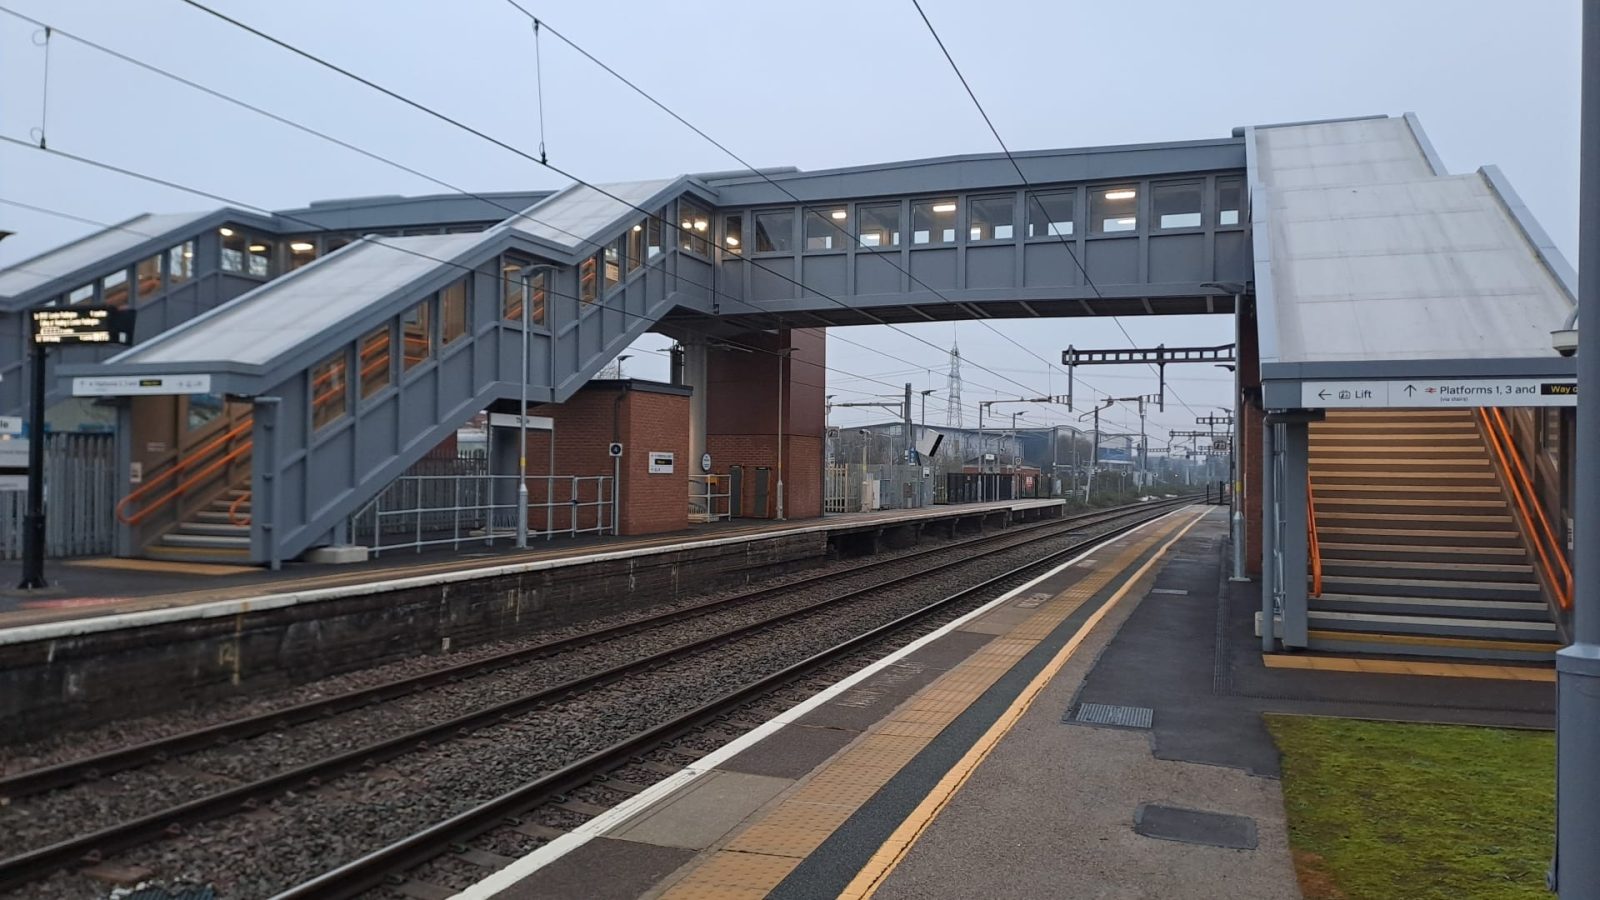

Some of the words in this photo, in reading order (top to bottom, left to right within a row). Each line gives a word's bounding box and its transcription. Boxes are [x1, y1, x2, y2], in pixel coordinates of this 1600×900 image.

[1355, 389, 1372, 399] Lift
[1439, 385, 1493, 395] Platforms
[1505, 385, 1512, 394] 3
[1515, 384, 1536, 394] and
[1551, 385, 1570, 394] Way
